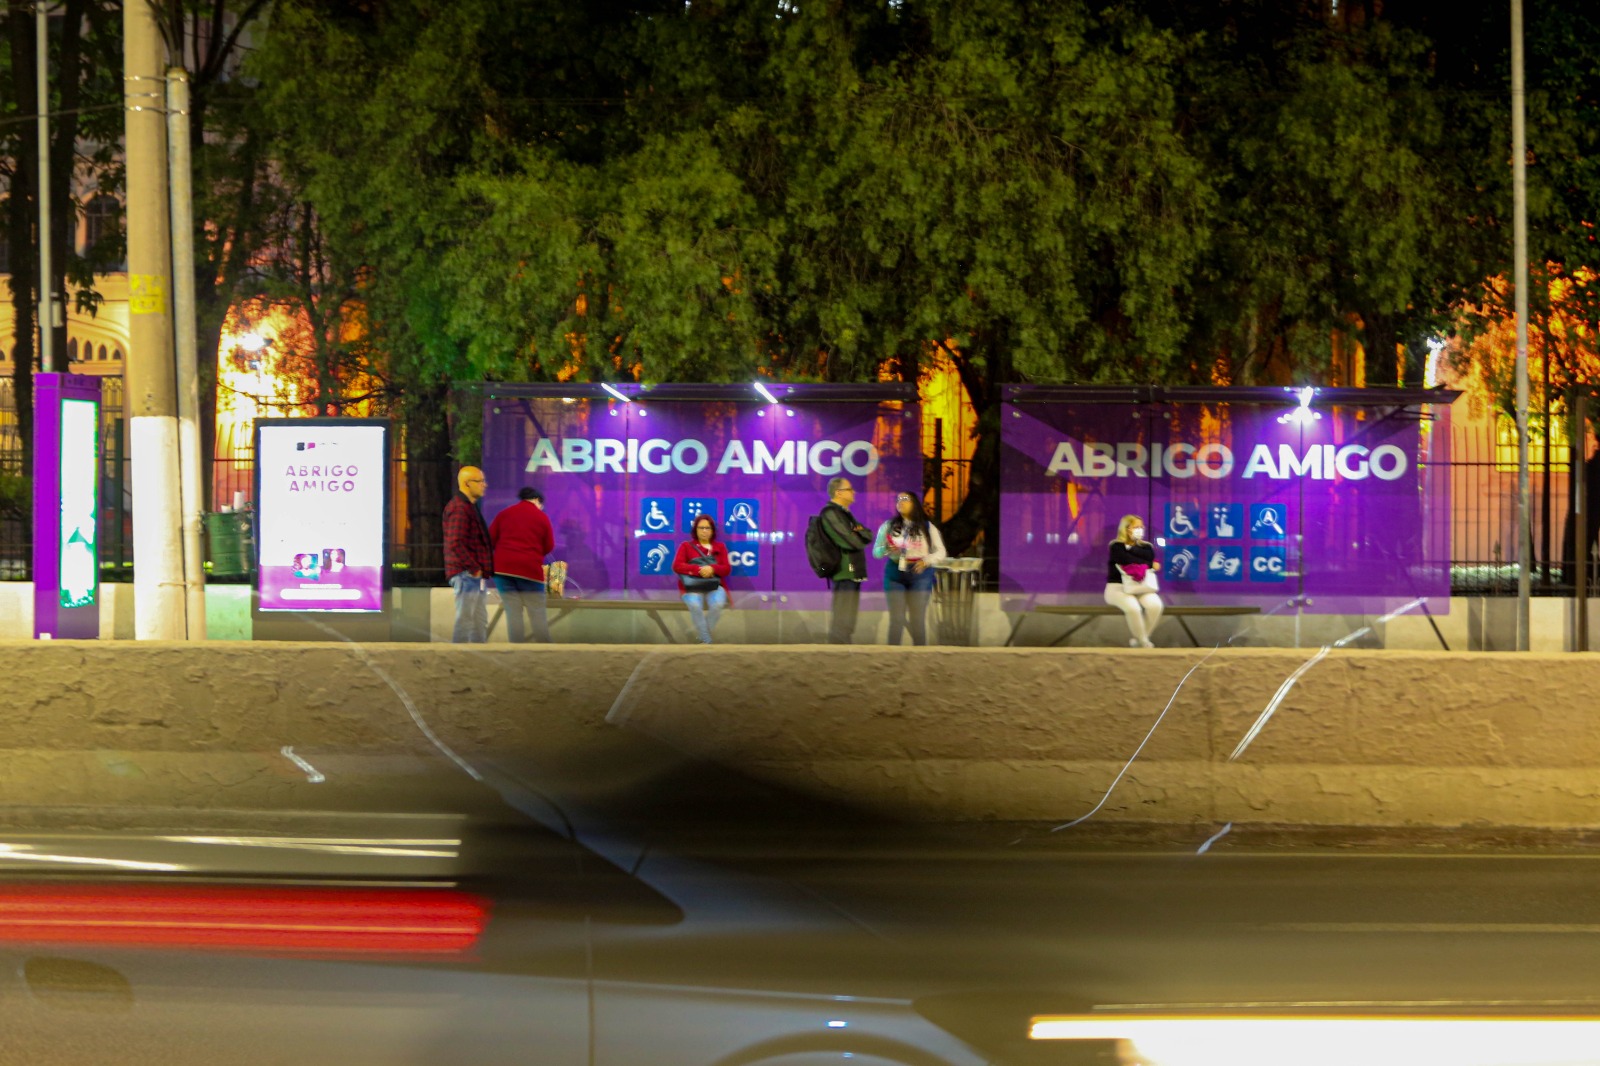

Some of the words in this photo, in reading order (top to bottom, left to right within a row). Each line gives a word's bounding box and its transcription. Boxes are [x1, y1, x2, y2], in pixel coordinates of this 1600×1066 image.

[525, 438, 708, 474] ABRIGO
[716, 439, 880, 476] AMIGO
[1045, 441, 1234, 479] ABRIGO
[1242, 444, 1408, 480] AMIGO
[285, 465, 359, 477] ABRIGO
[289, 480, 355, 492] AMIGO
[1253, 556, 1282, 572] CC
